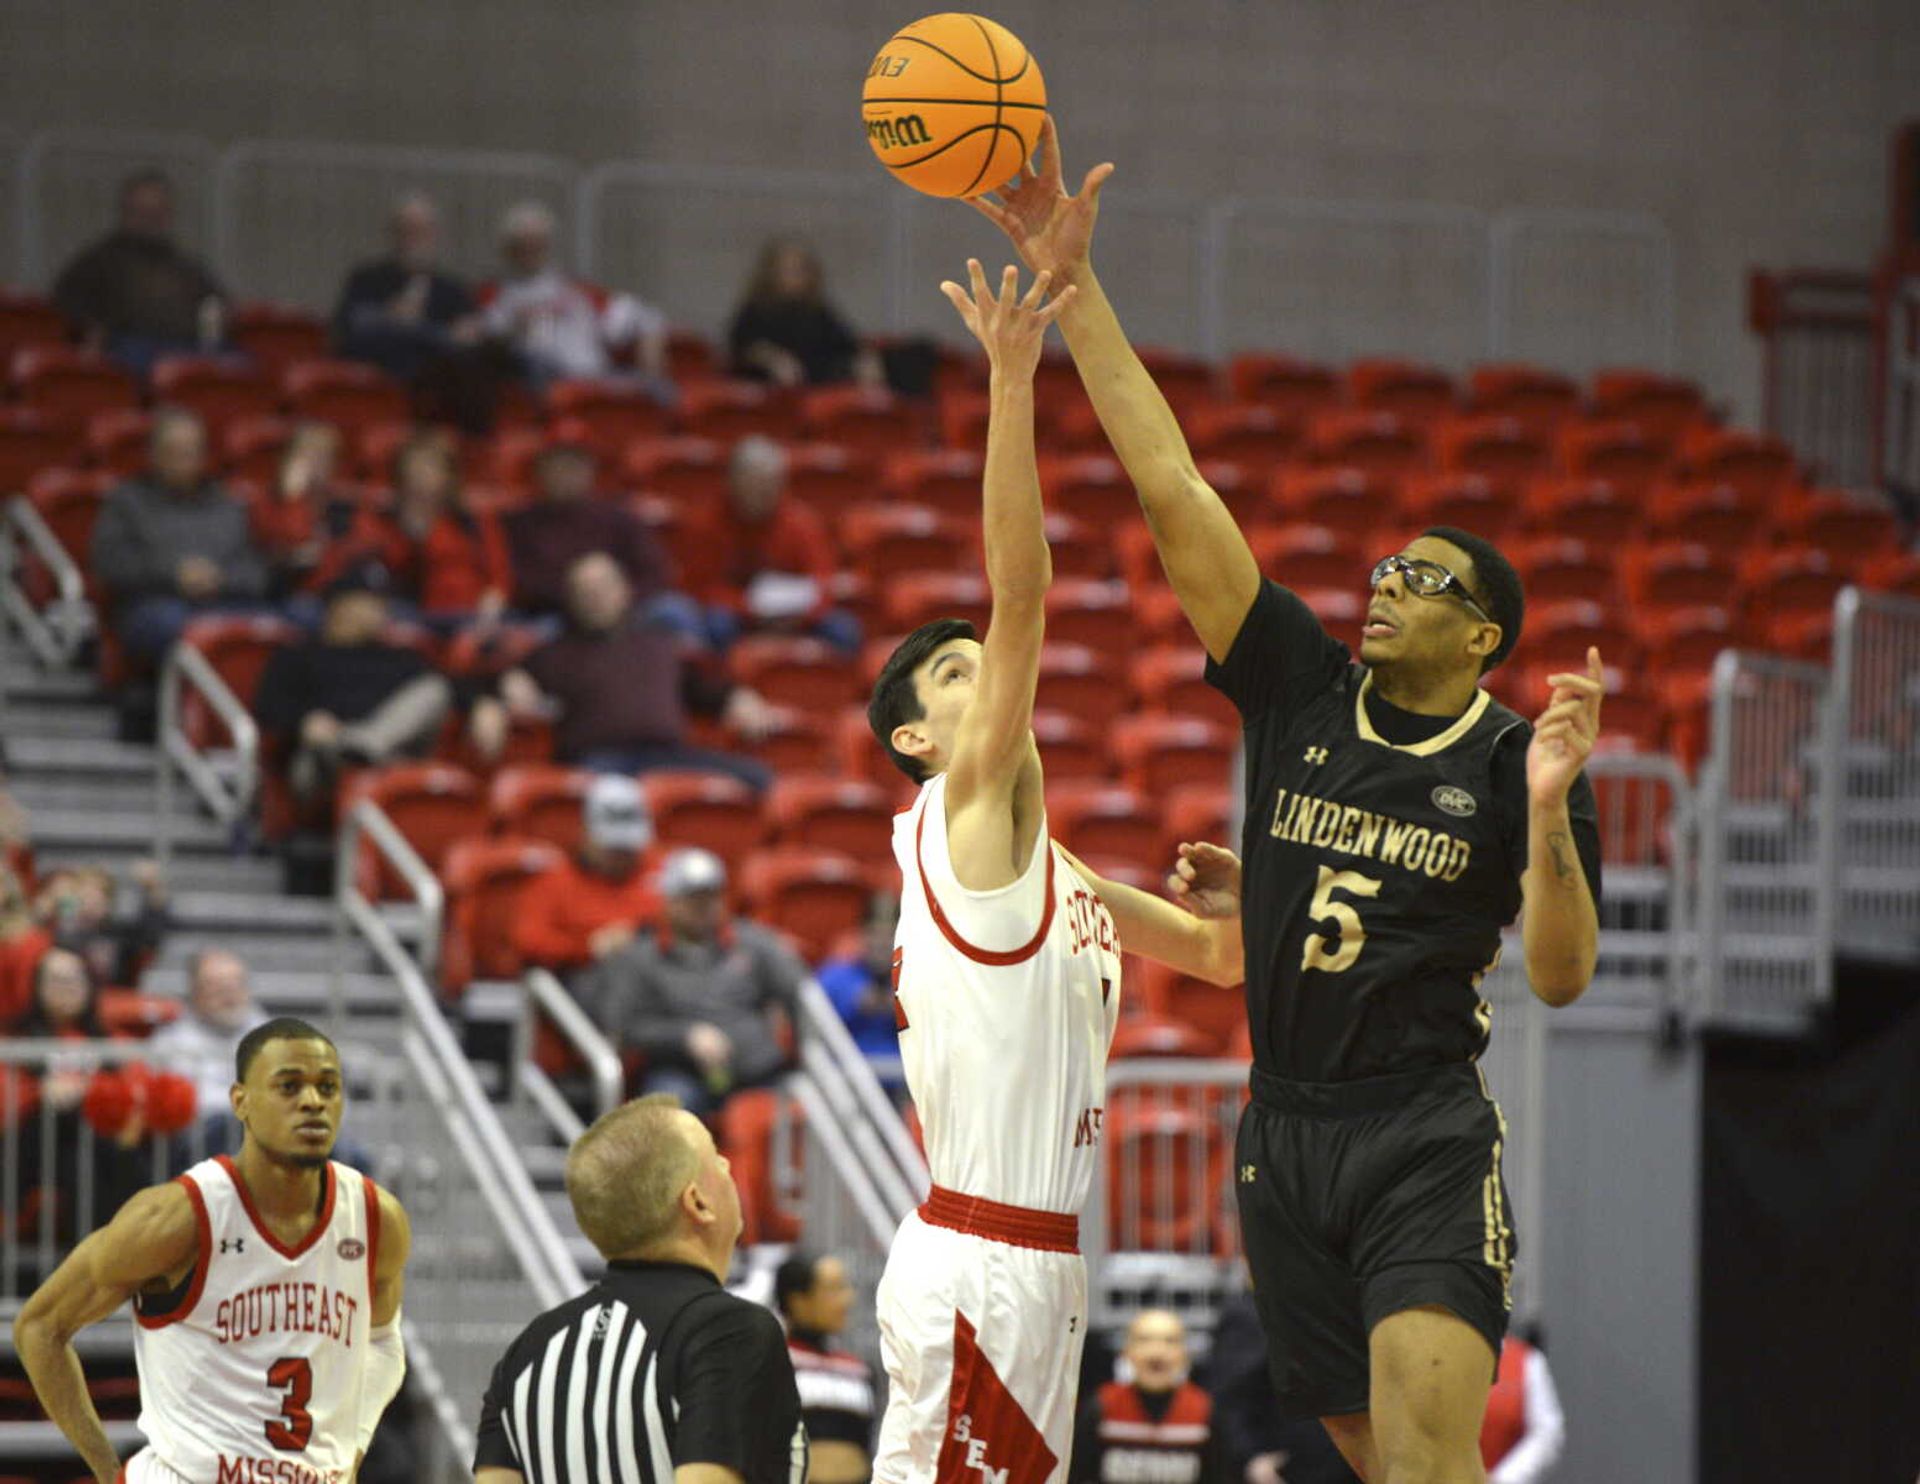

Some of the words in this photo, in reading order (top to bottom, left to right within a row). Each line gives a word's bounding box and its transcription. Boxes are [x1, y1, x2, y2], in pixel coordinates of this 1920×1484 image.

[864, 114, 932, 149] Wils
[1269, 788, 1471, 883] LINDENWOOD
[1301, 864, 1383, 973] 5
[216, 1282, 358, 1348] SOUTHEAST
[264, 1356, 313, 1452] 3
[216, 1453, 344, 1484] MISSO
